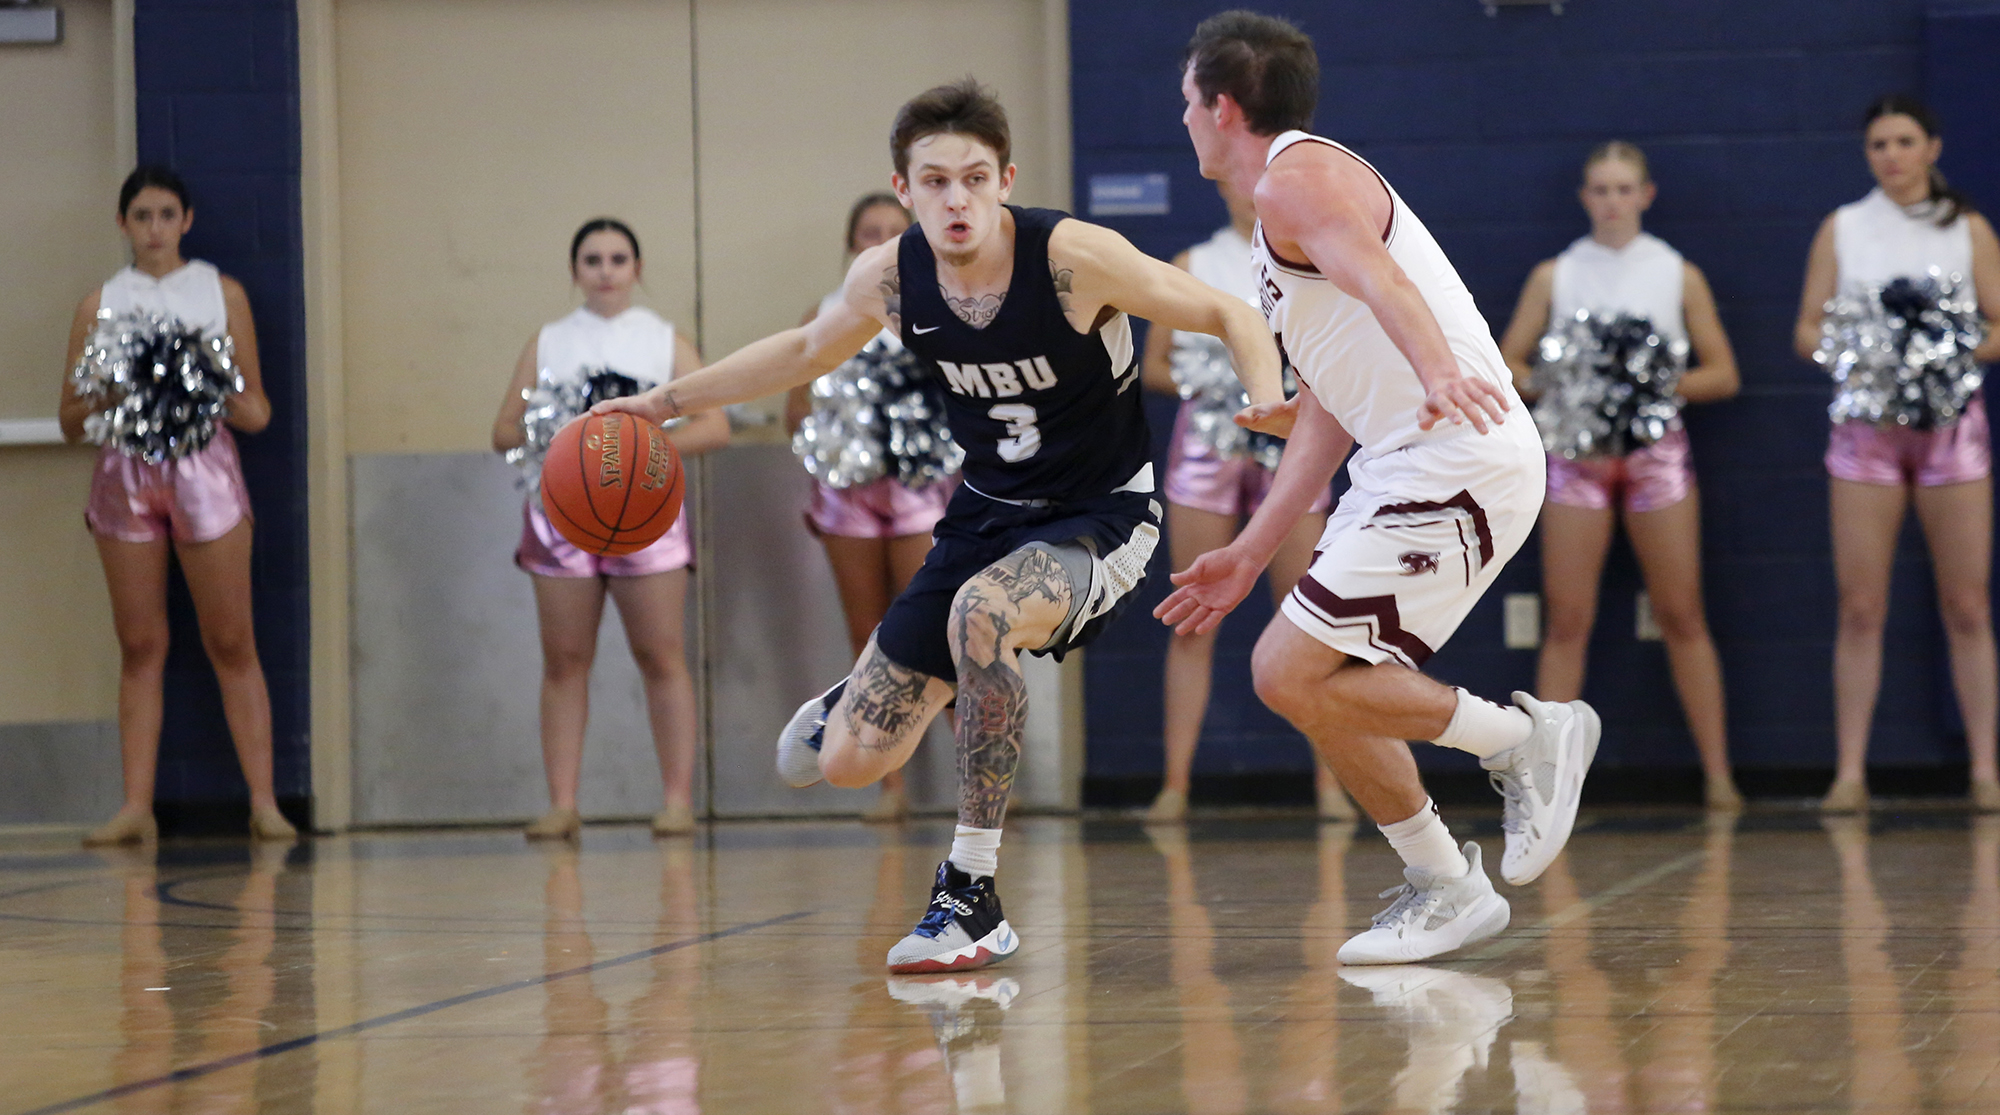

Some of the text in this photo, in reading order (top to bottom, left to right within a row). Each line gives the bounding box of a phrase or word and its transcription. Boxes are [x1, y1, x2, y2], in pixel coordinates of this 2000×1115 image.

[959, 303, 1000, 323] Stron
[936, 355, 1058, 398] MBU
[987, 403, 1042, 463] 3
[852, 693, 904, 734] FEAR
